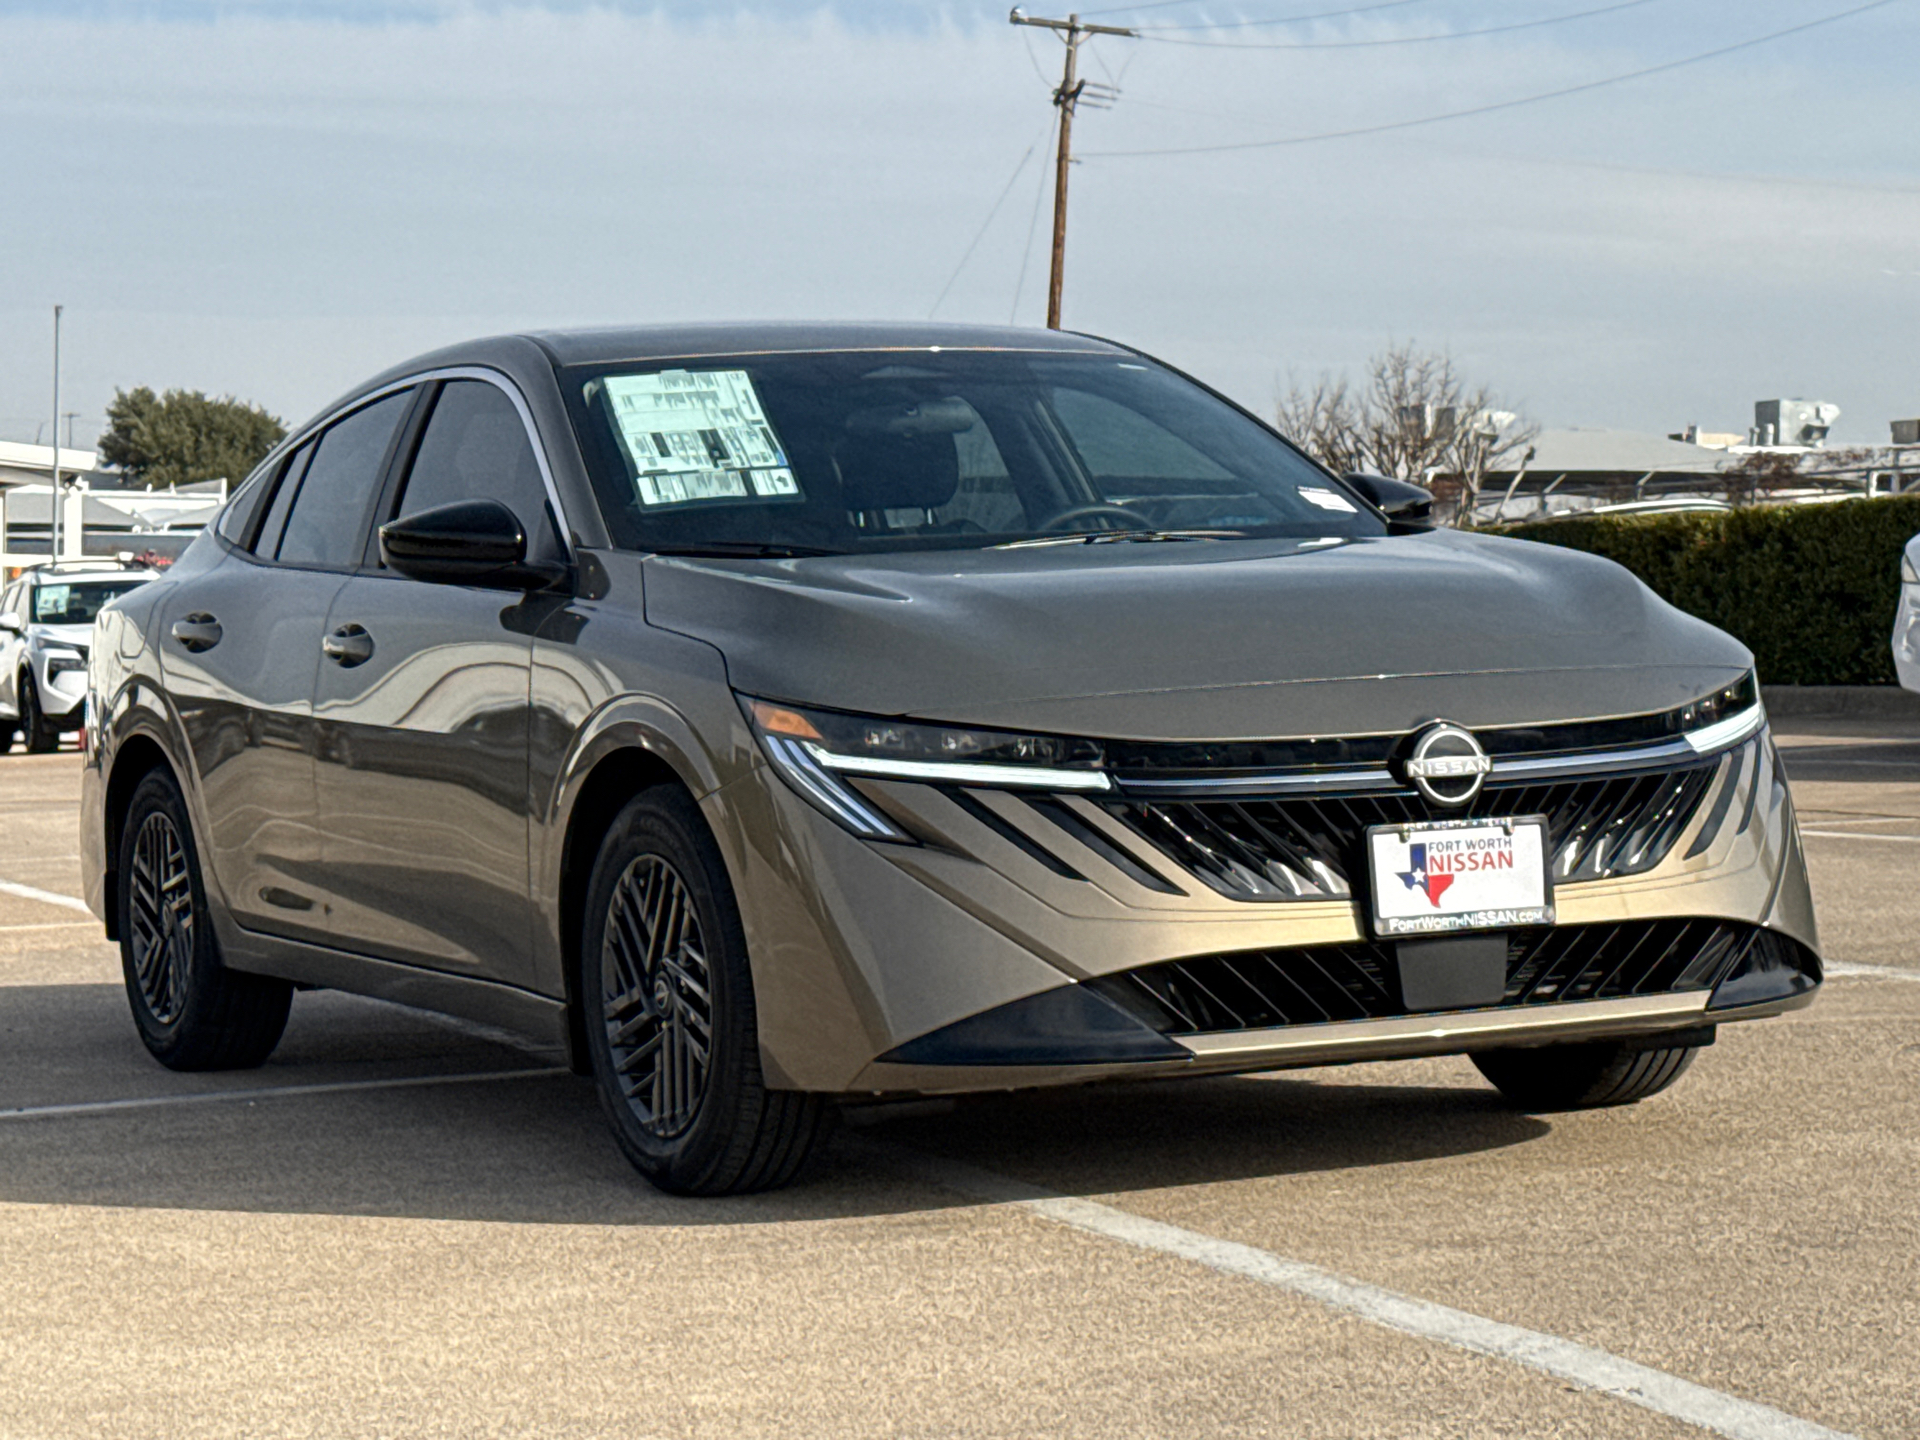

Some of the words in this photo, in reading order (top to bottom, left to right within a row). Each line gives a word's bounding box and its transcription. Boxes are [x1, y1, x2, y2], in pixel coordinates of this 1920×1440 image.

[1408, 758, 1491, 776] NISSAN
[1428, 840, 1462, 853] FORT
[1466, 837, 1512, 851] WORTH
[1429, 850, 1513, 872] NISSAN
